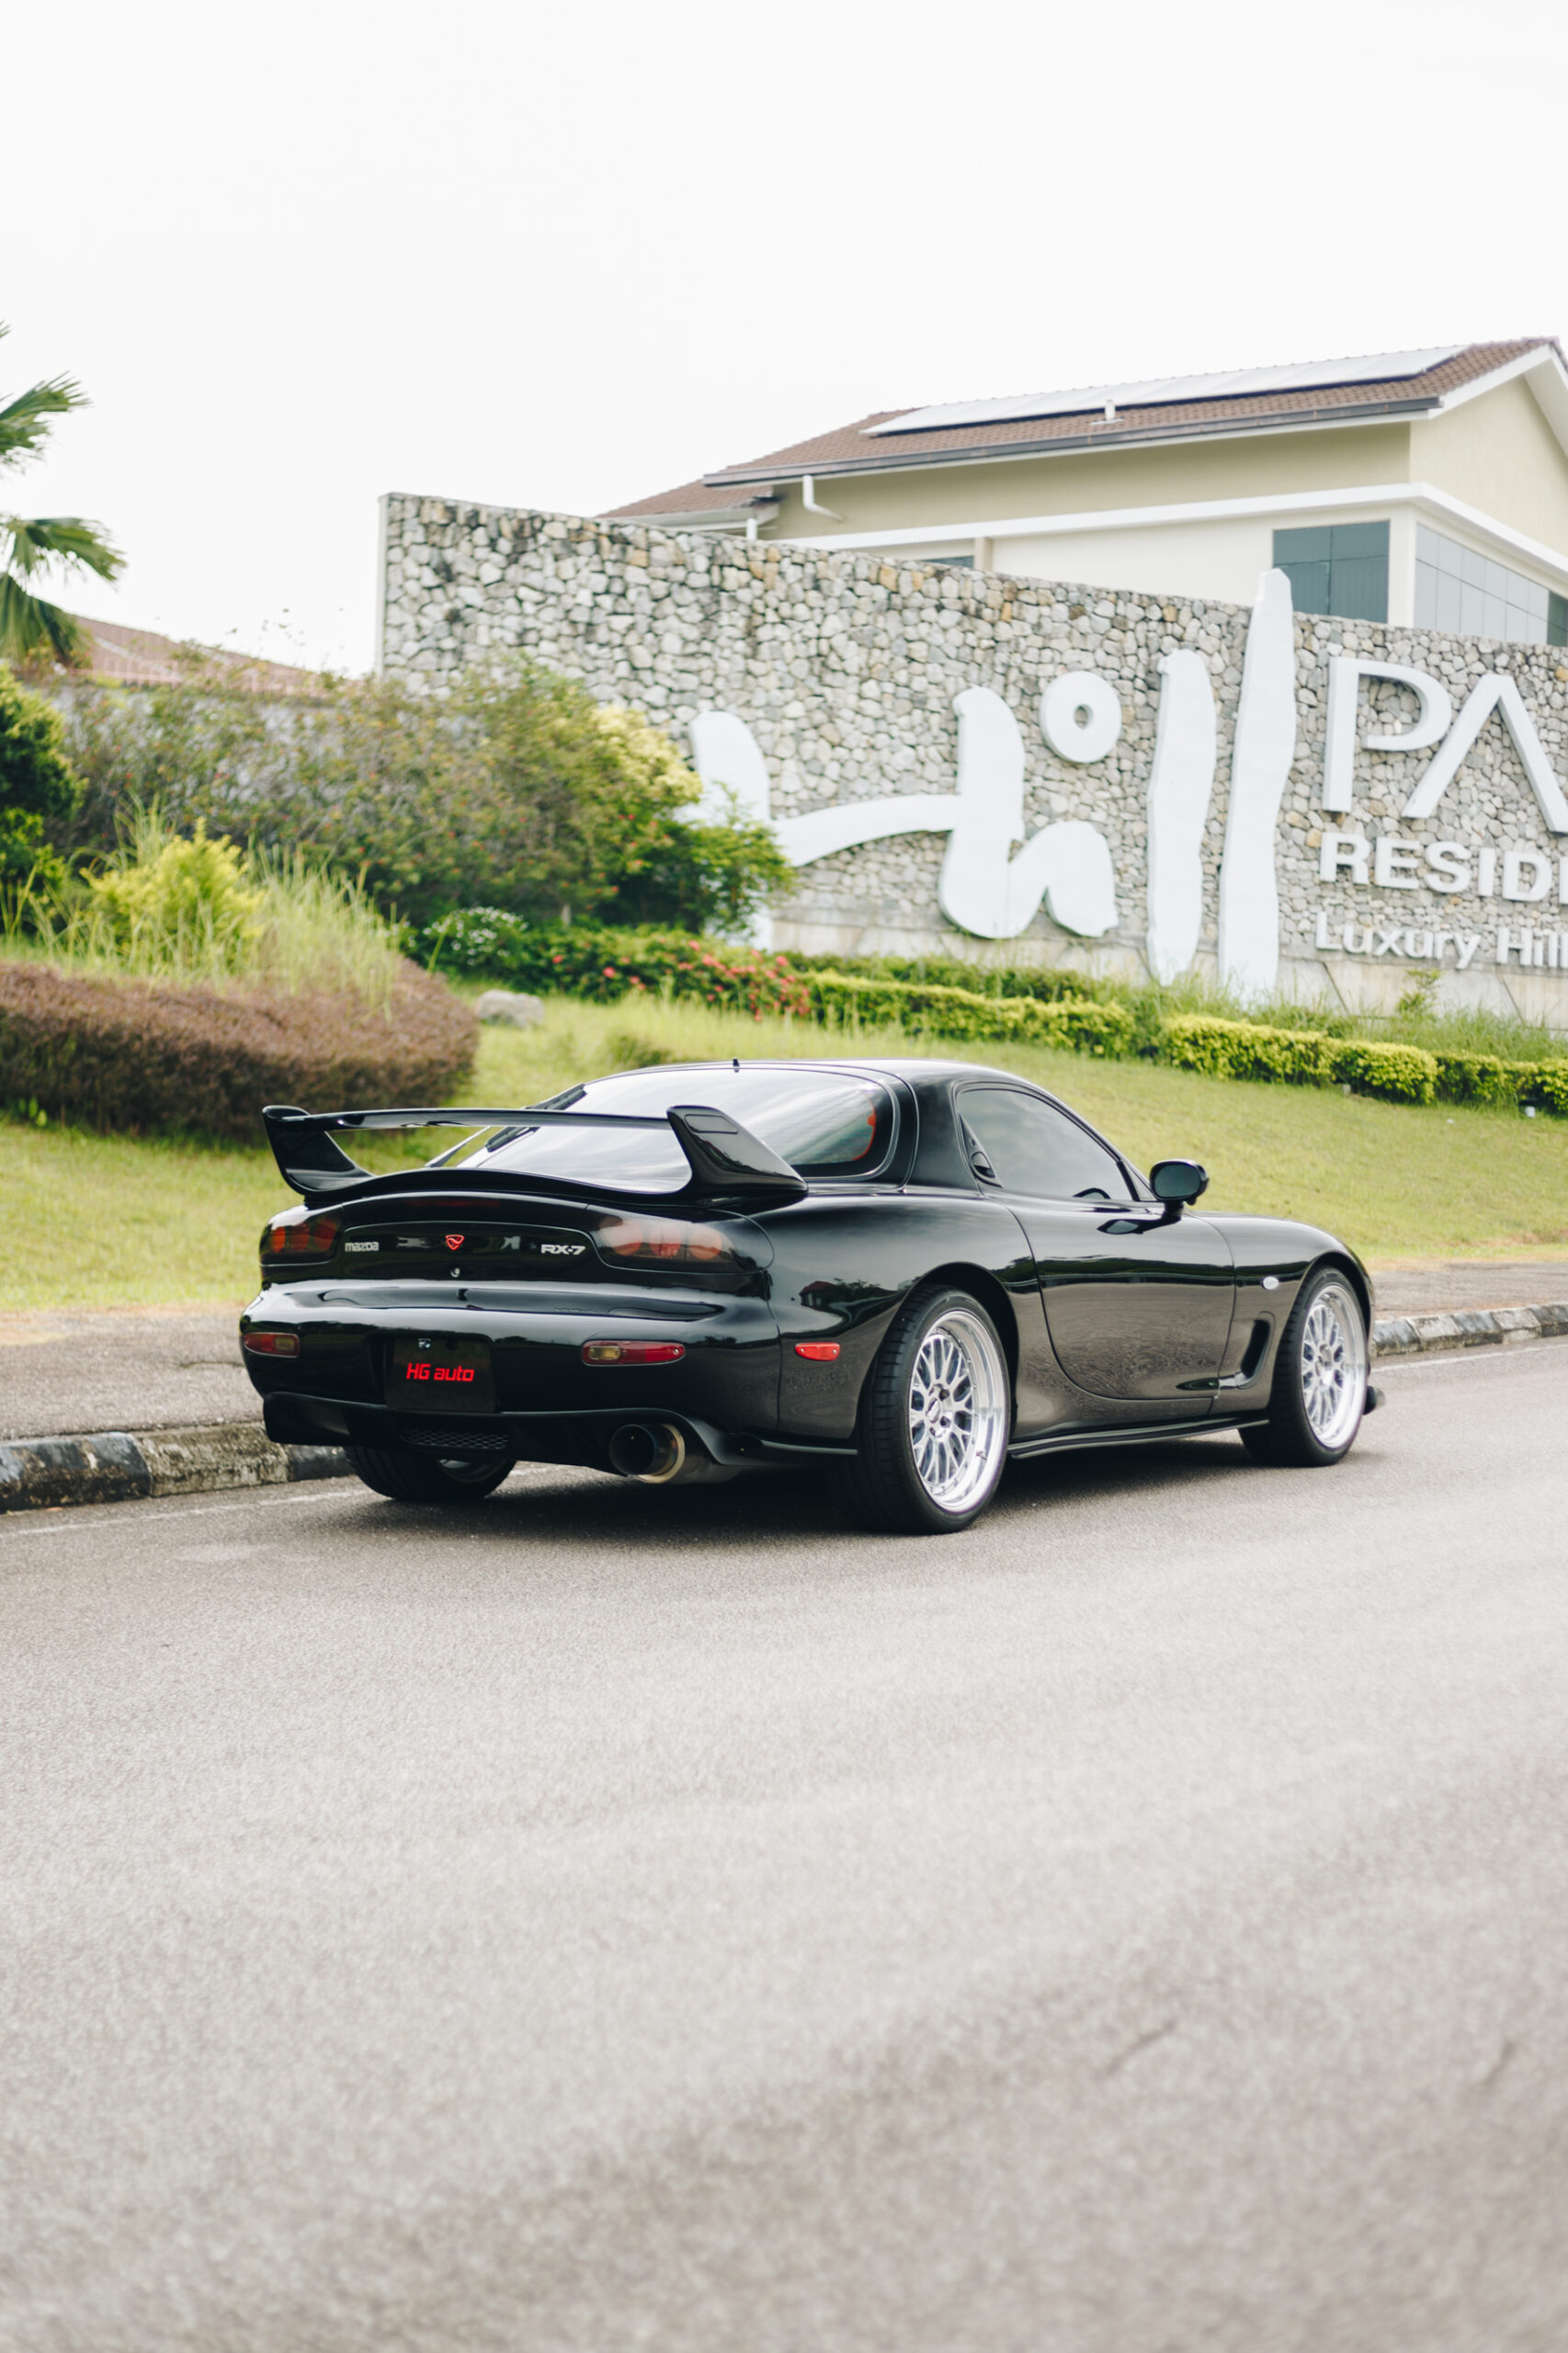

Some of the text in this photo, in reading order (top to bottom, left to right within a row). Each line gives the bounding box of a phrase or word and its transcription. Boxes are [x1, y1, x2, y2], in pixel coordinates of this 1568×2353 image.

[1319, 831, 1568, 905] RESID
[1315, 911, 1481, 970] Luxury
[405, 1362, 475, 1382] HG auto
